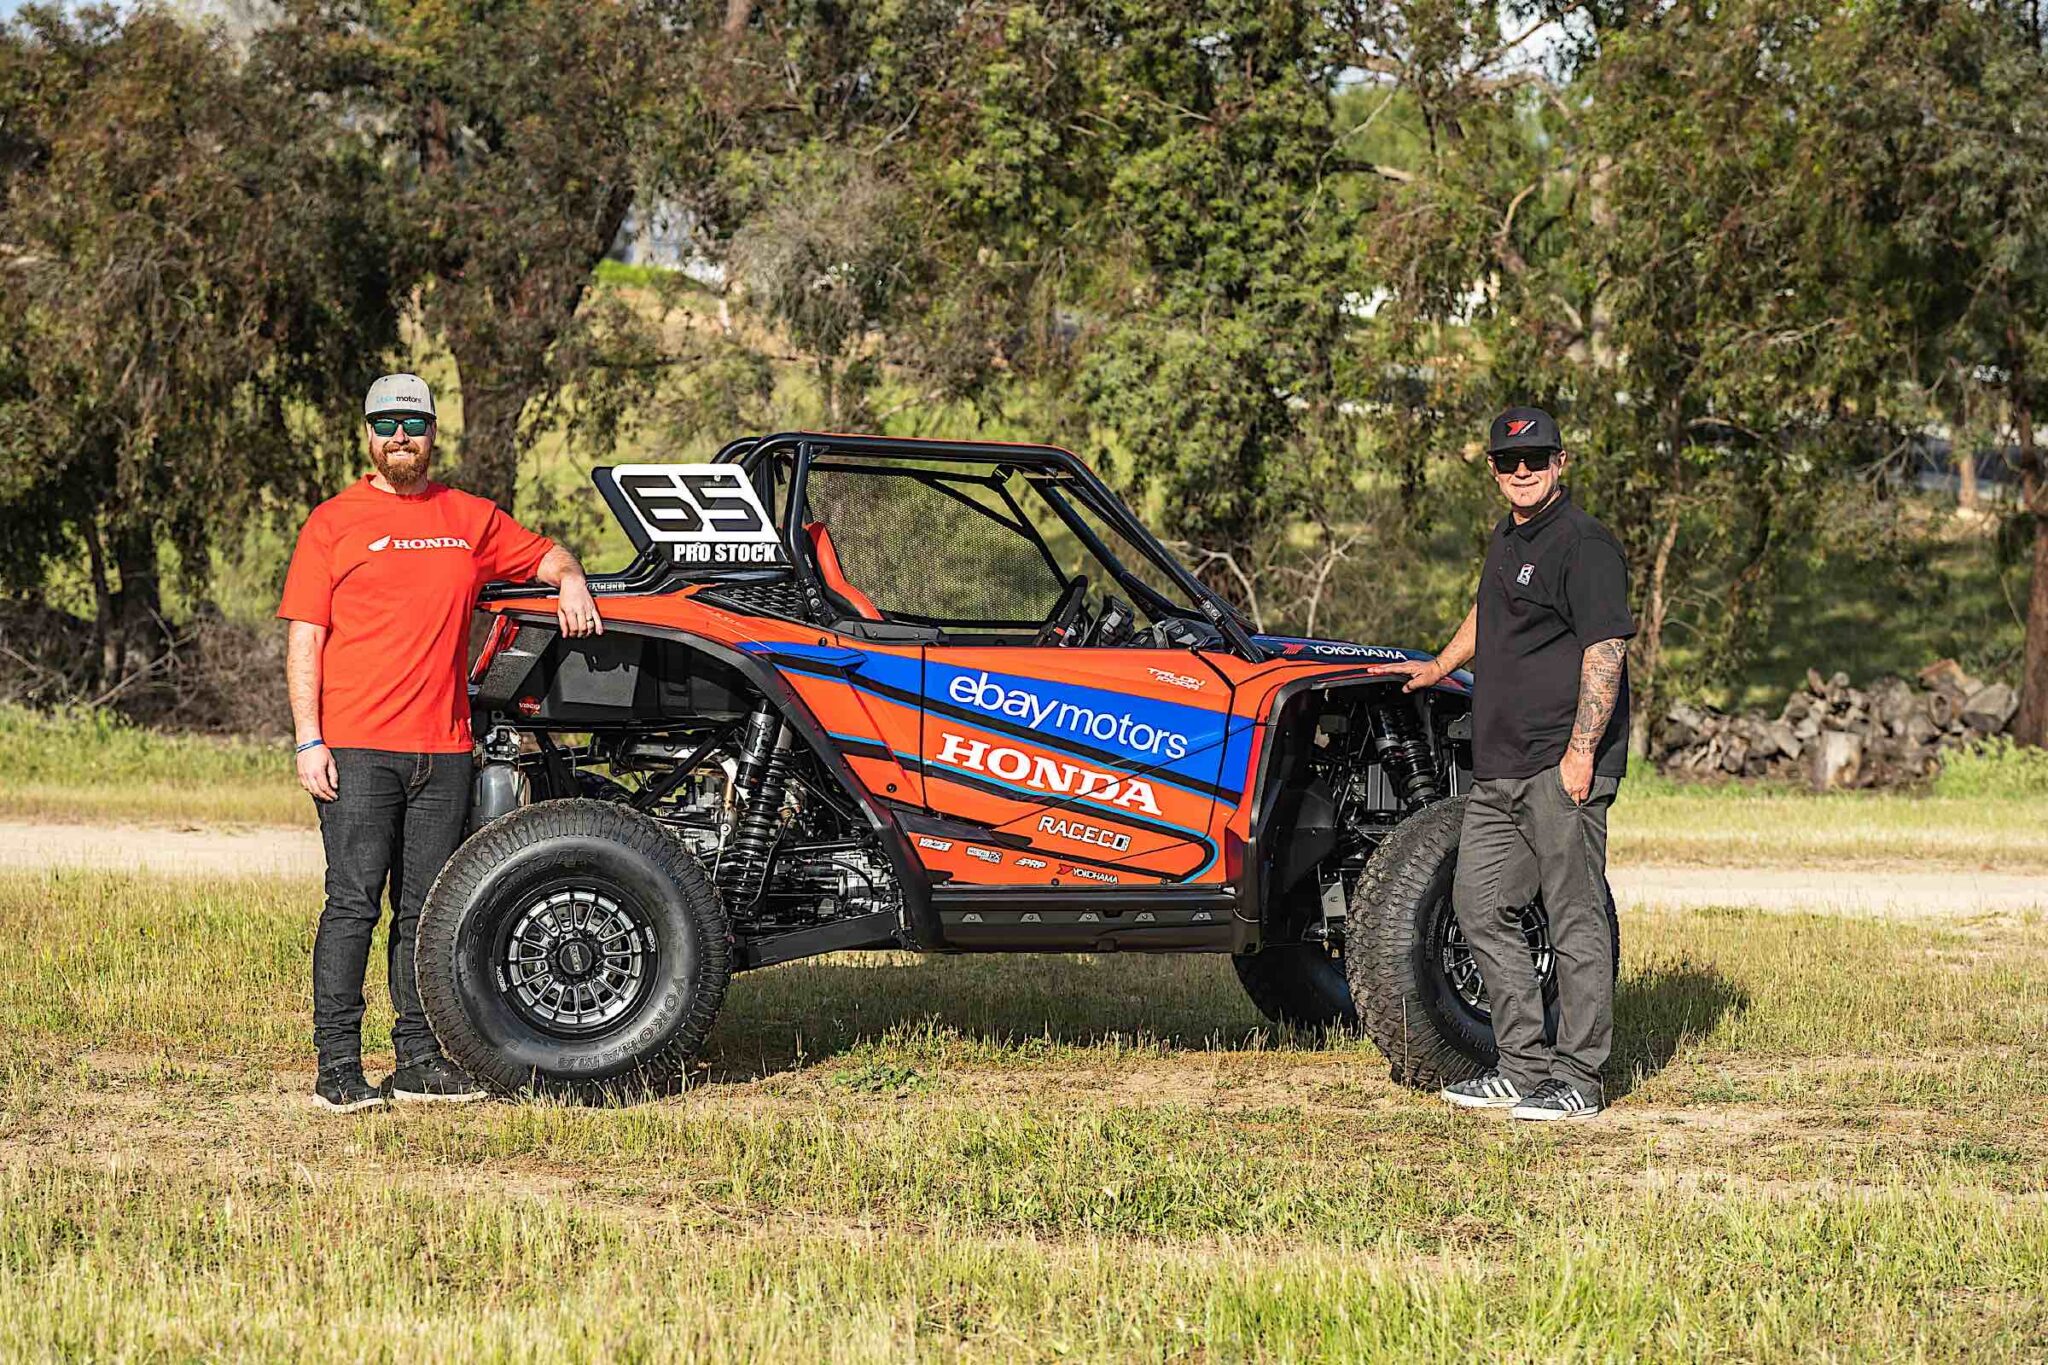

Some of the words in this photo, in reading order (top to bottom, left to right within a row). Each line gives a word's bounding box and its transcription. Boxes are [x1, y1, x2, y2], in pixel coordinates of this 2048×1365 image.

[619, 475, 764, 532] 65
[392, 537, 472, 550] HONDA
[673, 543, 711, 562] PRO
[714, 543, 777, 562] STOCK
[1309, 645, 1408, 660] YOKOHAMA
[949, 672, 1059, 730] ebay
[1056, 701, 1189, 759] motors
[936, 731, 1164, 816] HONDA
[1037, 815, 1132, 852] RACECO
[1072, 867, 1119, 885] YOKOHAMA
